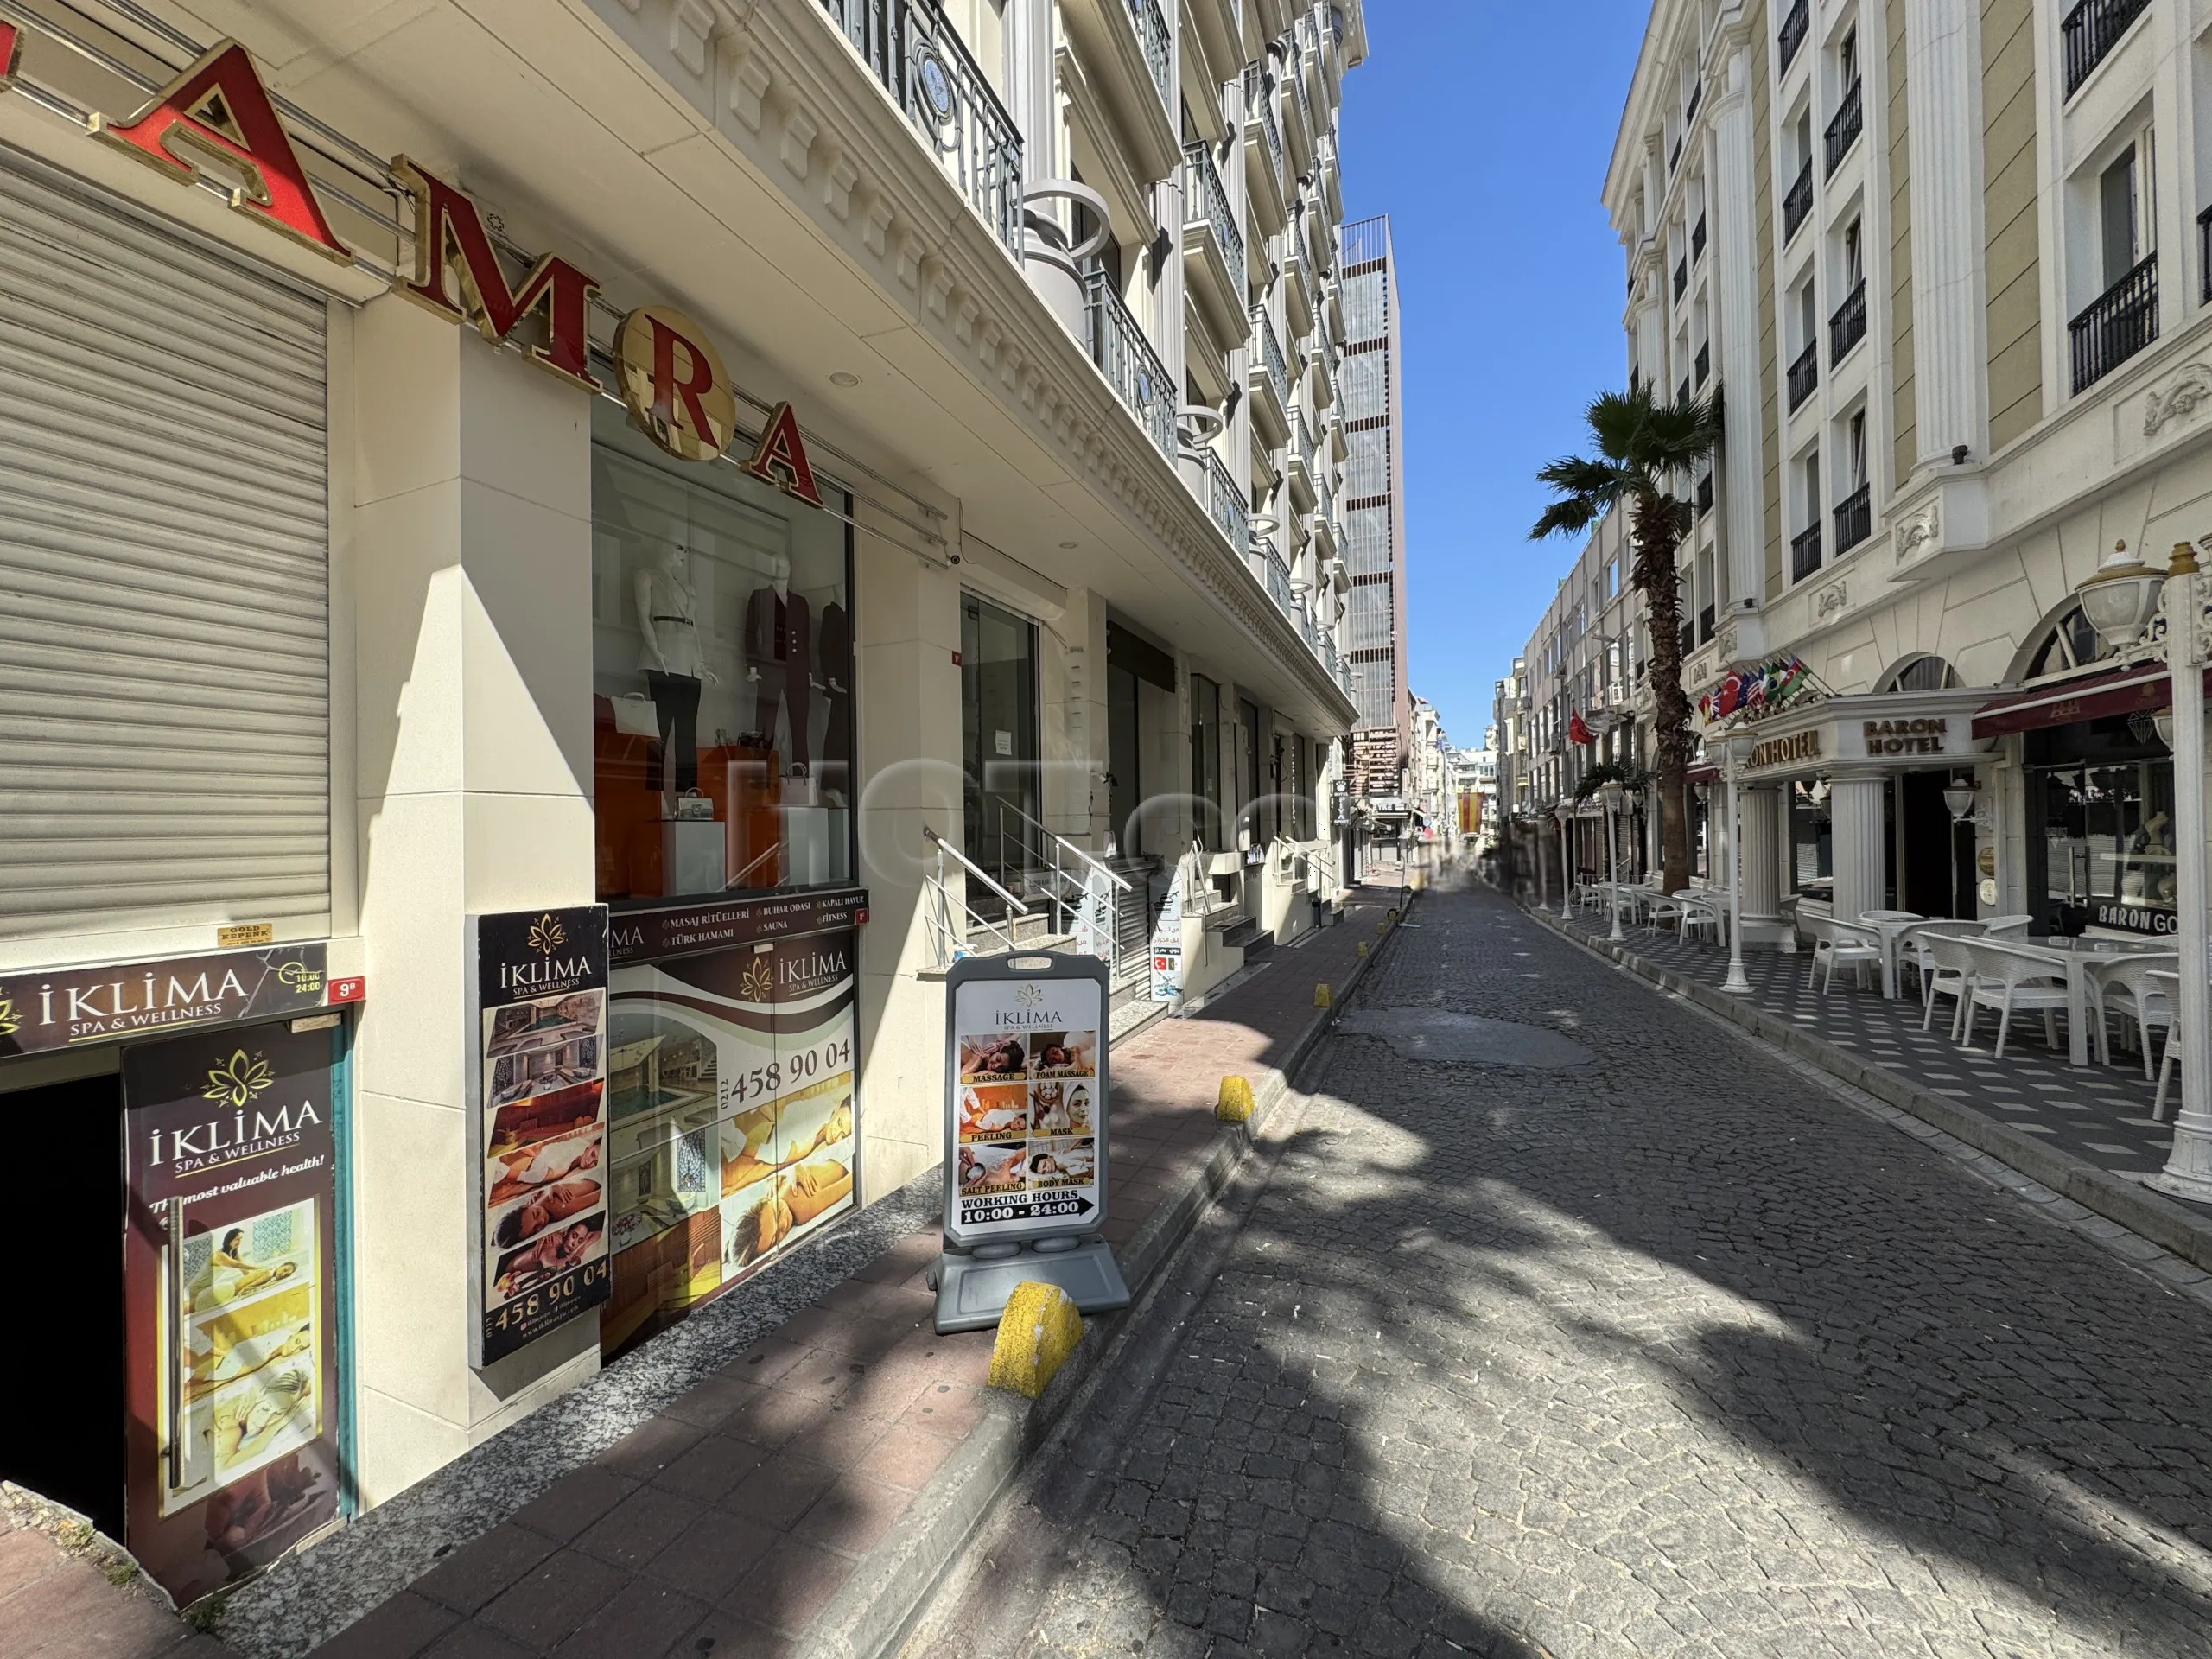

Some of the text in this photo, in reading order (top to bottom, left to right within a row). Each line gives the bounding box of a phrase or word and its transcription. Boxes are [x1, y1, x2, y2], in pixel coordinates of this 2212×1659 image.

[0, 21, 823, 510] AMRA
[1863, 718, 1948, 736] BARON
[1746, 730, 1821, 767] ON HOTEL
[1866, 736, 1944, 756] HOTEL
[611, 895, 864, 948] MA MASAJ RİTÜELLERİ BUHAR ODASI KAPALI HAVUZ
[671, 933, 696, 946] TÜRK
[698, 928, 734, 942] HAMAMI
[763, 920, 788, 931] SAUNA
[822, 912, 848, 923] FİTNESS
[2098, 904, 2178, 934] BARON GO
[500, 956, 592, 988] İKLİMA
[779, 950, 847, 984] İKLİMA
[296, 982, 321, 994] 24:00
[513, 987, 528, 995] SPA
[538, 978, 580, 991] WELLNESS
[789, 973, 838, 992] SPA & WELLNESS
[39, 969, 249, 1026] İKLİMA
[70, 1002, 222, 1036] SPA & WELLNESS
[995, 1009, 1063, 1026] İKLİMA
[720, 1038, 851, 1110] 0212 458 90 04
[973, 1073, 1015, 1082] MASSAGE
[1037, 1070, 1089, 1079] FOAM MASSAGE
[149, 1100, 322, 1166] İKLİMA
[971, 1132, 1012, 1141] PEELING
[1050, 1128, 1073, 1136] MASK
[175, 1132, 300, 1173] SPA & WELLNESS
[149, 1154, 325, 1214] Th most valuable health!
[961, 1182, 1022, 1196] SALT PEELING
[1038, 1179, 1060, 1188] BODY
[962, 1190, 1078, 1209] WORKING HOURS
[964, 1207, 1014, 1223] 10:00
[1030, 1201, 1079, 1215] 24:00
[495, 1294, 539, 1330] 458
[549, 1276, 575, 1305] 90
[583, 1260, 607, 1287] 04
